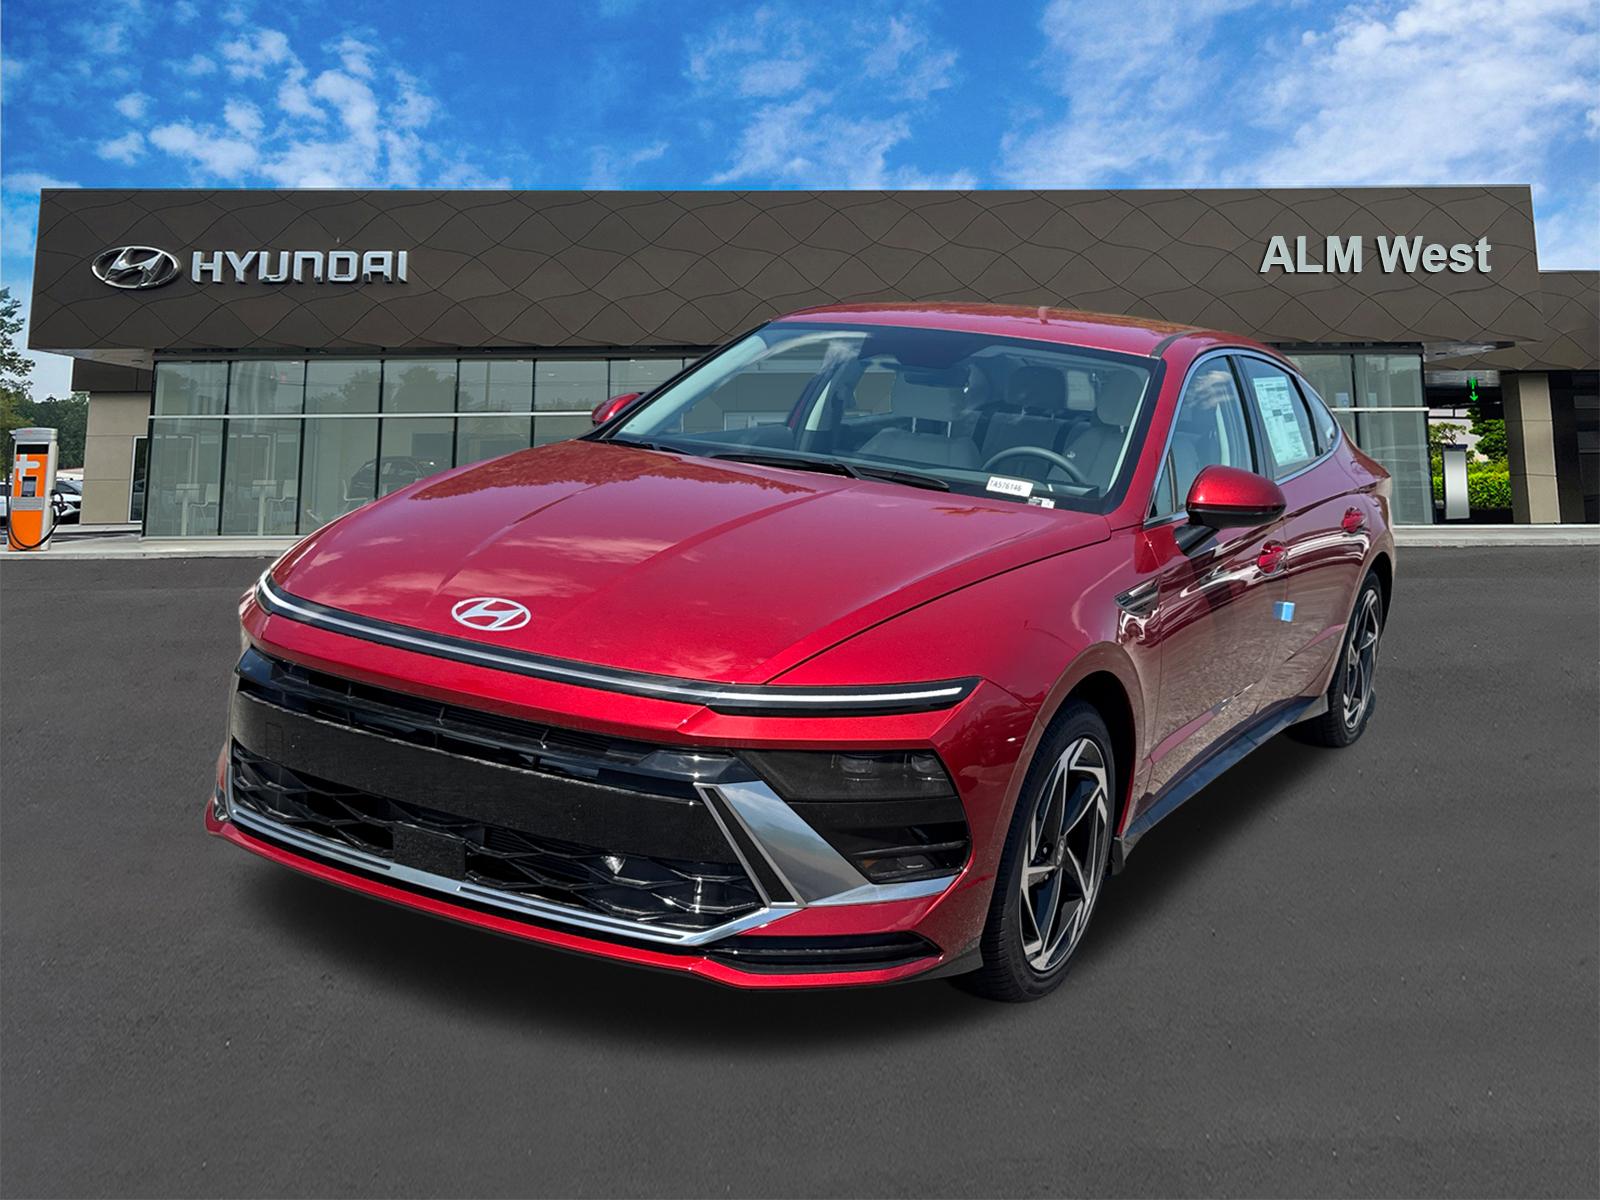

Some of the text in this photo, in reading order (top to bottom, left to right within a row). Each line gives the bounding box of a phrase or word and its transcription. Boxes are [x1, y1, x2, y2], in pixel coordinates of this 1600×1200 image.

[191, 250, 409, 284] HYUNDAI
[1259, 235, 1493, 273] ALM West
